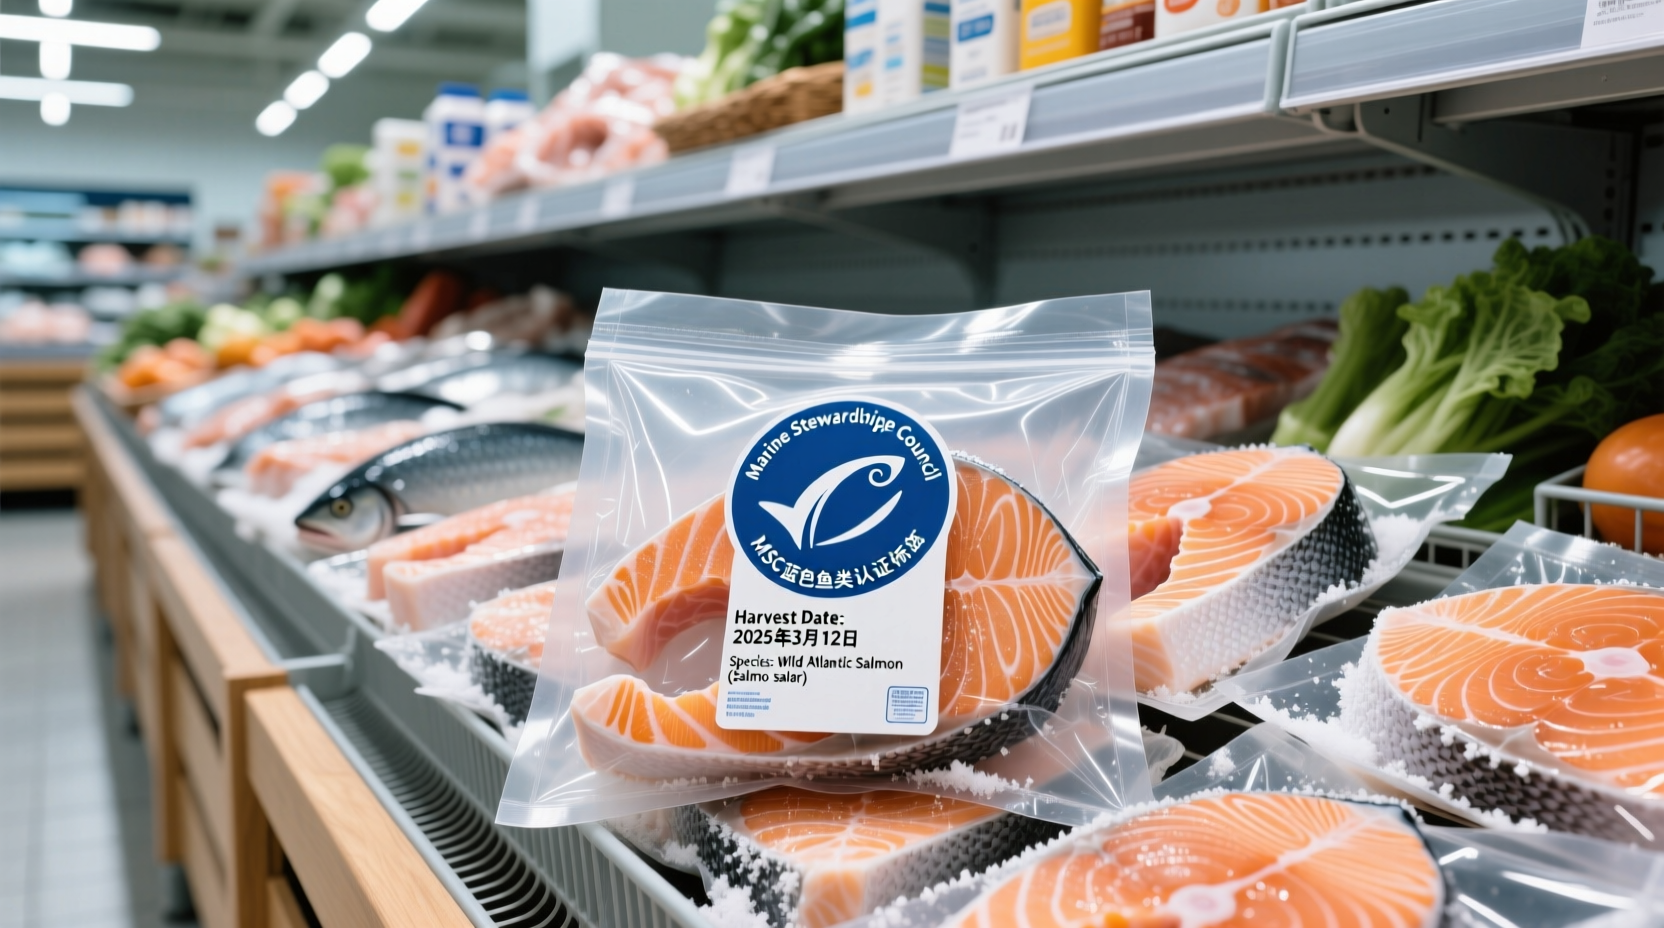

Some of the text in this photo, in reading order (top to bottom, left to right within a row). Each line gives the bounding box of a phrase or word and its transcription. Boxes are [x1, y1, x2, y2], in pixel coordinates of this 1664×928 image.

[746, 431, 791, 481] Marine
[734, 609, 845, 625] Harvest Date:
[732, 628, 858, 648] 2025年3月12日
[729, 654, 774, 671] Species:
[855, 656, 904, 670] Salmon
[773, 671, 808, 687] salar)
